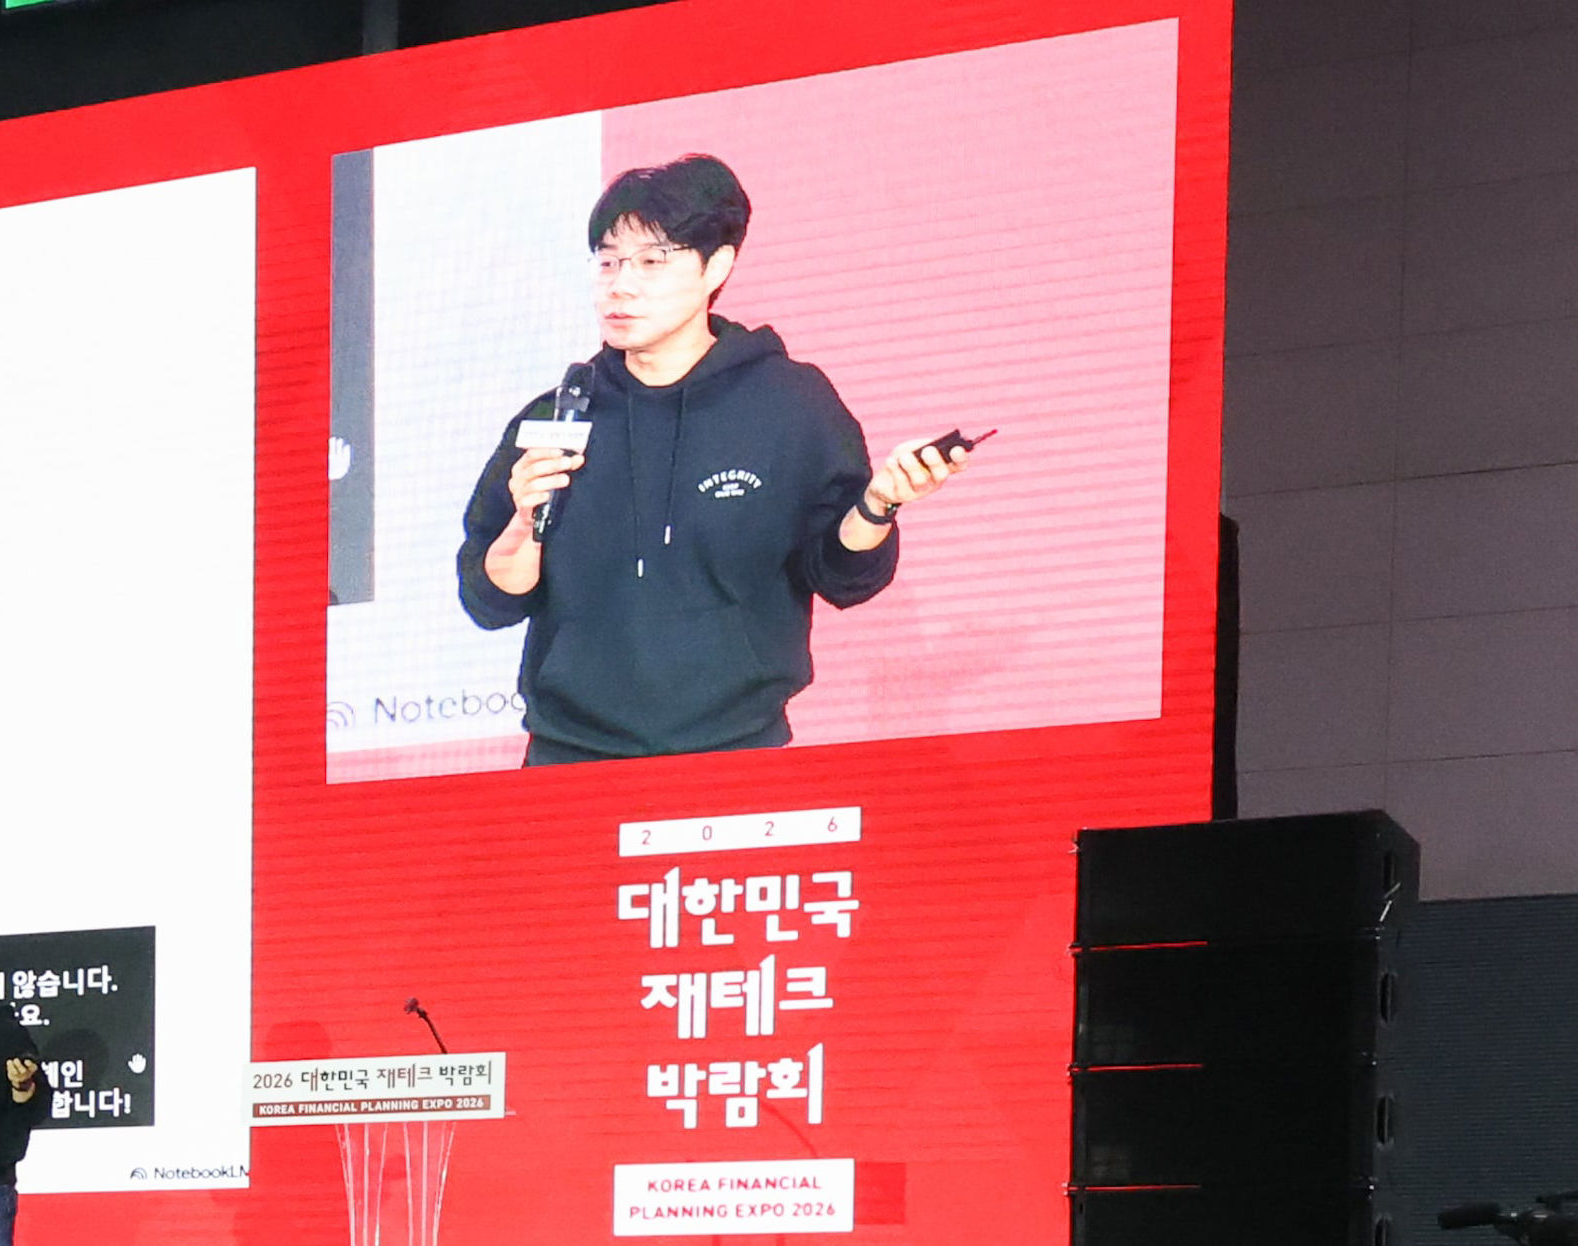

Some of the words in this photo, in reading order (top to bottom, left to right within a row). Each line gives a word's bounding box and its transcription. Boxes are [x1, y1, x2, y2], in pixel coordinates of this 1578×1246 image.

[698, 469, 762, 493] INTEGRITY
[617, 866, 860, 949] 대한민국
[12, 965, 118, 999] 않습니다.
[640, 954, 834, 1039] 재테크
[253, 1073, 293, 1089] 2026
[301, 1067, 370, 1091] 대한민국
[376, 1062, 433, 1089] 재테크
[439, 1060, 492, 1086] 박람회
[647, 1042, 824, 1130] 박람회
[259, 1104, 295, 1116] KOREA
[298, 1101, 358, 1115] FINANCIAL
[360, 1099, 419, 1112] PLANNING
[422, 1097, 453, 1110] EXPO
[456, 1096, 484, 1109] 2026
[647, 1176, 711, 1193] KOREA
[718, 1175, 822, 1191] FINANCIAL
[629, 1203, 729, 1220] PLANNING
[735, 1202, 785, 1217] EXPO
[792, 1201, 836, 1217] 2026
